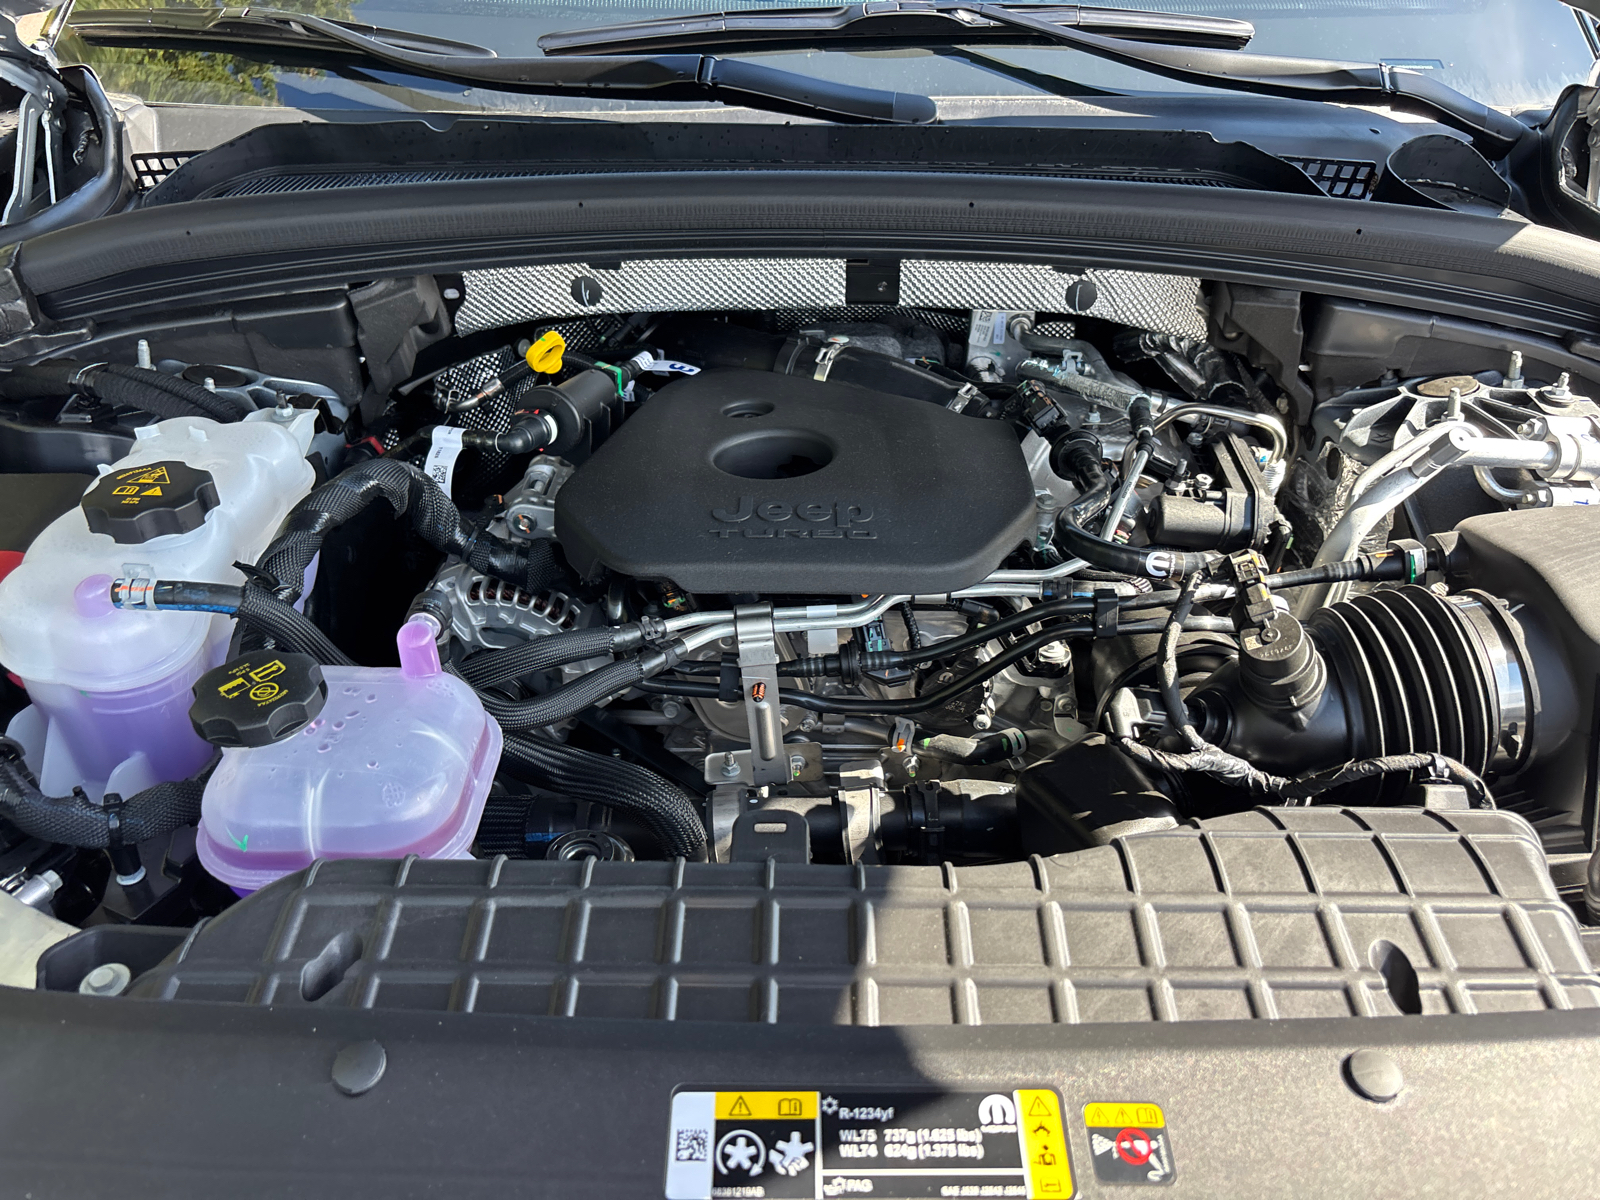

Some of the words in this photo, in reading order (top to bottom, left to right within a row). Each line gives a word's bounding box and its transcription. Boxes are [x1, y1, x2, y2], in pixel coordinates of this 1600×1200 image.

[712, 495, 874, 528] Jeep
[708, 529, 877, 540] TURBO
[839, 1107, 895, 1122] R-1234yf
[839, 1128, 877, 1142] WL75
[883, 1128, 916, 1144] 737g
[839, 1143, 878, 1158] WL74
[846, 1178, 873, 1193] PAG
